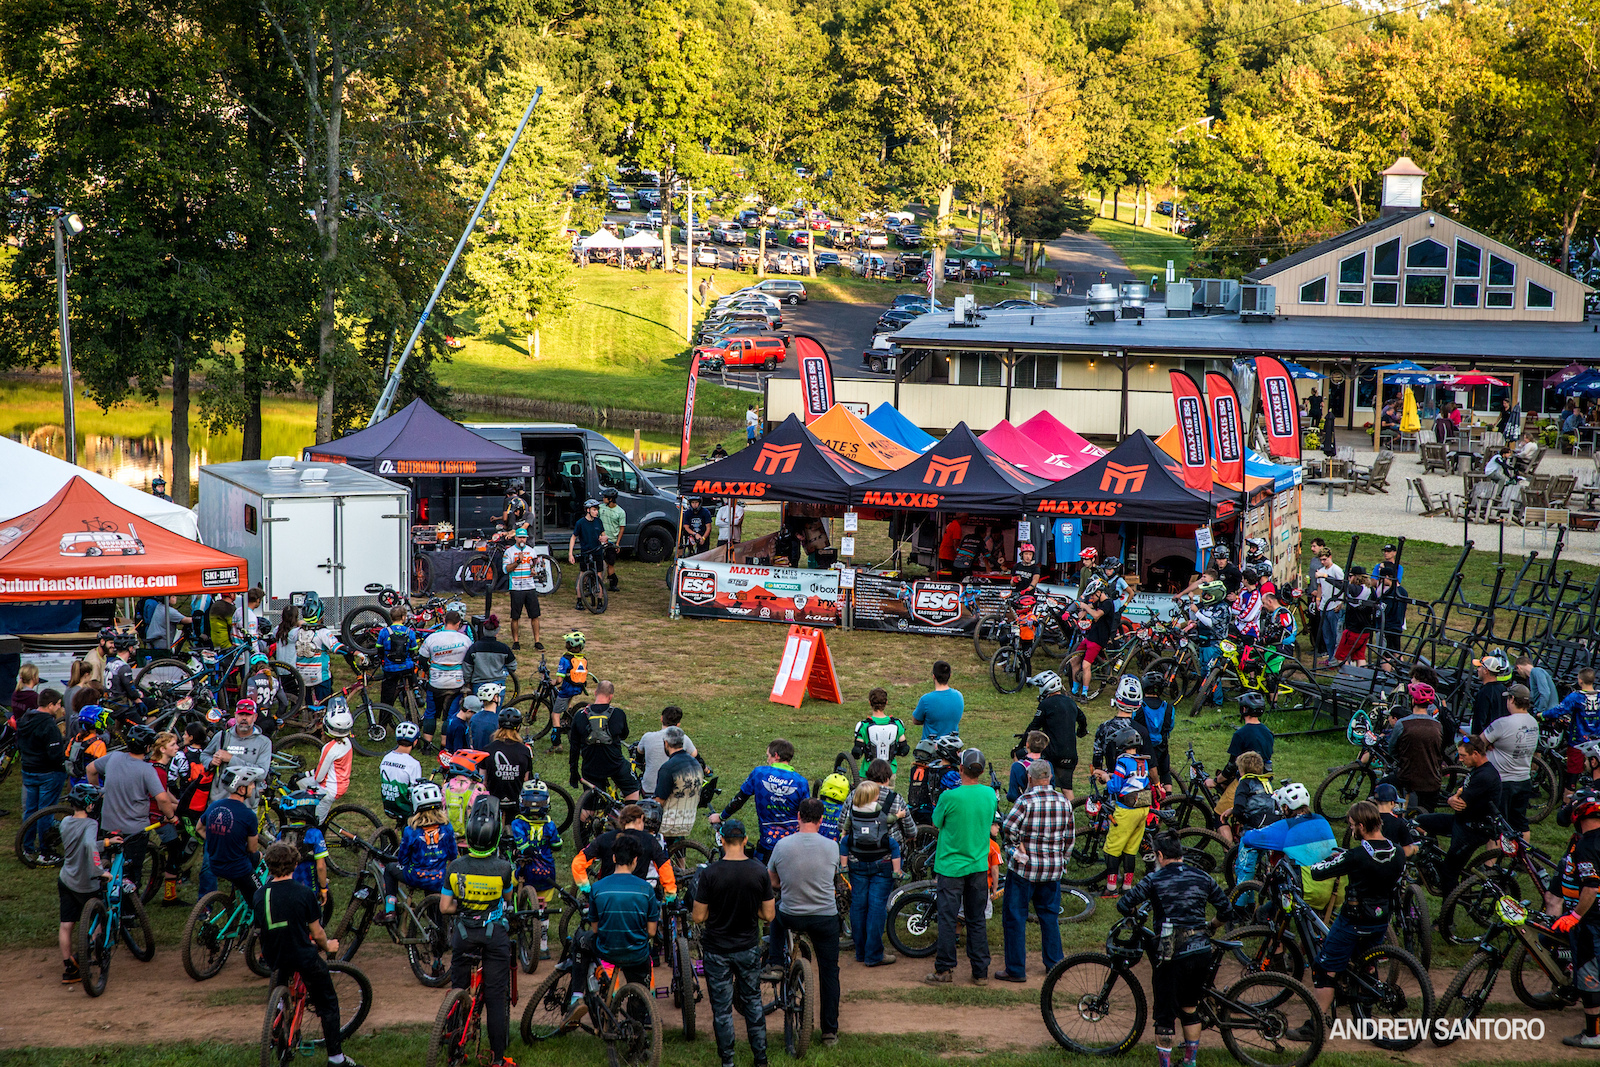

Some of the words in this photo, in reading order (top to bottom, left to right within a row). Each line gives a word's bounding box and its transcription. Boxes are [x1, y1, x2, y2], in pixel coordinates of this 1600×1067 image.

[807, 360, 818, 372] ESC
[815, 360, 823, 369] CUP
[817, 369, 825, 388] STATES
[809, 373, 822, 411] MAXXIS
[1270, 380, 1278, 396] ESC
[1218, 400, 1226, 416] ESC
[1280, 389, 1288, 411] STATES
[1183, 400, 1193, 417] ESC
[1271, 396, 1285, 433] MAXXIS
[1192, 411, 1200, 434] STATES
[1227, 410, 1235, 432] STATES
[1283, 411, 1291, 432] EASTERN
[1184, 417, 1199, 462] MAXXIS
[1219, 417, 1232, 458] MAXXIS
[1194, 435, 1203, 461] EASTERN
[397, 460, 440, 474] OUTBOUND
[441, 461, 477, 474] LIGHTING
[693, 480, 768, 496] MAXXIS
[863, 491, 941, 508] MAXXIS
[1037, 499, 1119, 517] MAXXIS
[729, 566, 770, 576] MAXXIS
[782, 569, 798, 577] KATE'S
[0, 574, 178, 593] SuburbanSkiAndBike.com
[682, 578, 715, 593] ESC
[773, 583, 800, 591] MOTOREX
[820, 585, 836, 594] box
[818, 599, 836, 608] FOX
[916, 591, 960, 610] ESC
[495, 770, 520, 778] Ones
[496, 763, 519, 773] Wild
[382, 783, 399, 792] Wild
[768, 775, 788, 786] Stage
[382, 790, 400, 798] Ones
